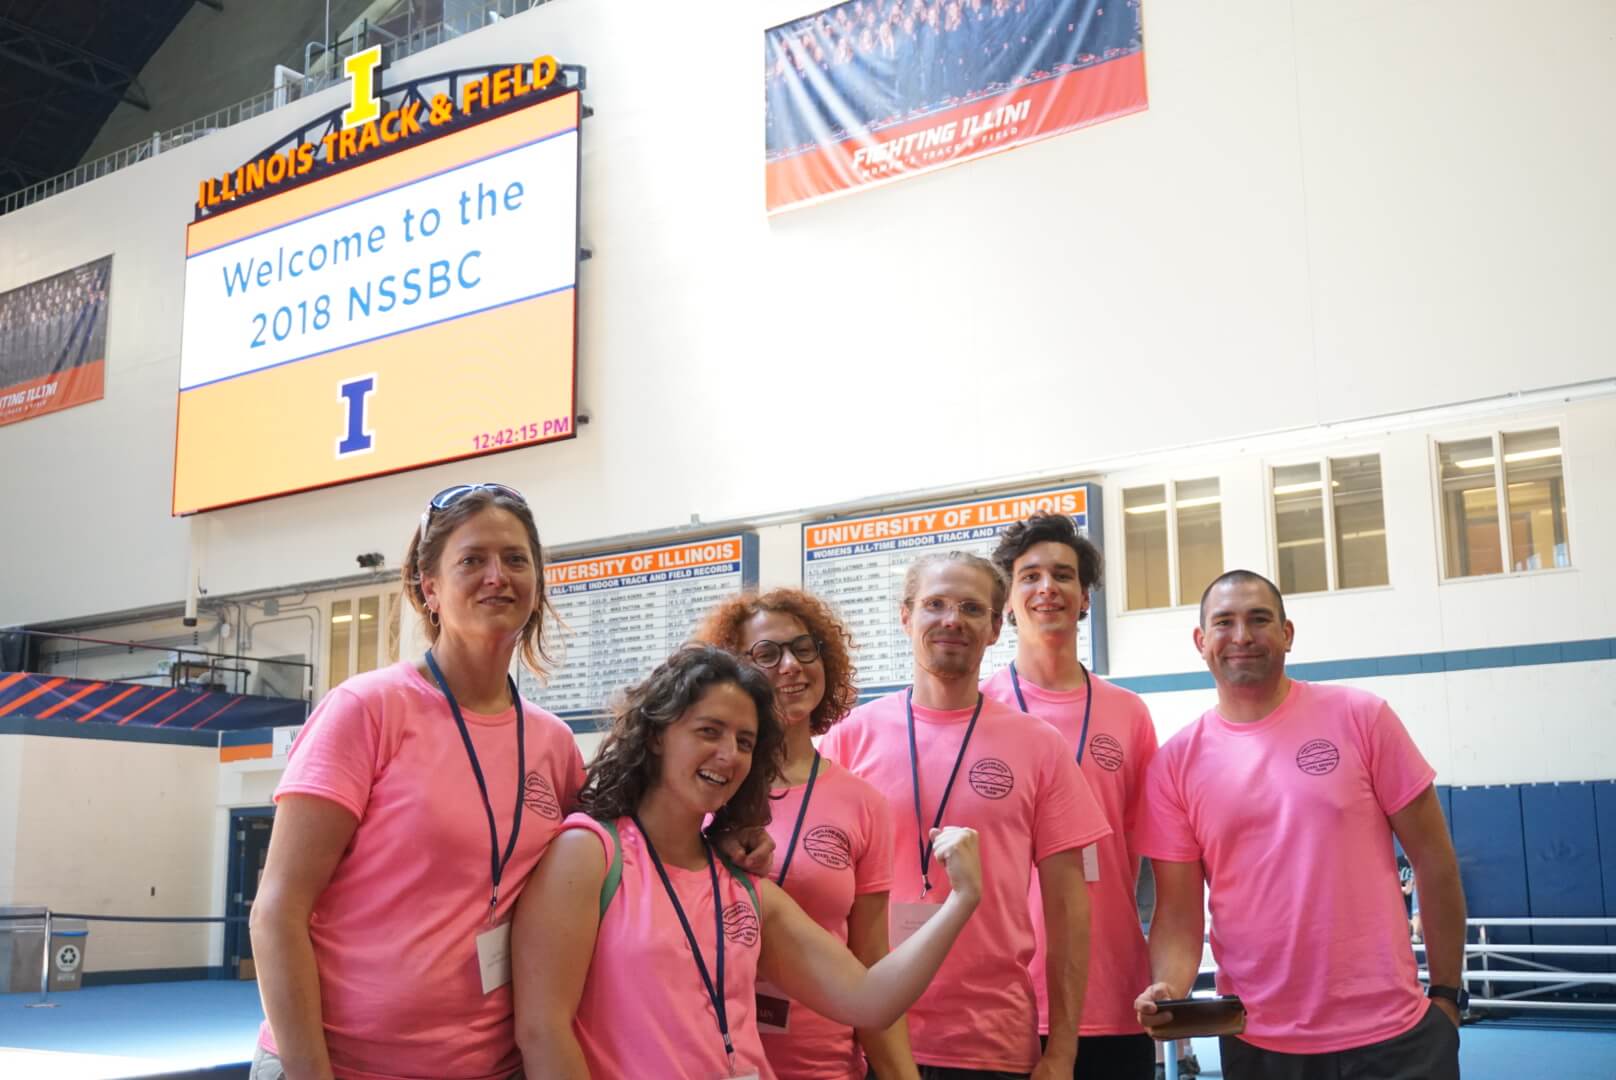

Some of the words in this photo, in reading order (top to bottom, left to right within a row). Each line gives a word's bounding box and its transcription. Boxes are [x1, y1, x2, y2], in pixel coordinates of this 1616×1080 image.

[198, 143, 313, 208] ILLINOIS
[323, 101, 421, 165] TRACK
[429, 93, 453, 127] &
[463, 55, 559, 115] FIELD
[852, 122, 957, 169] FIGHTING
[961, 99, 1032, 137] ILLINI
[222, 225, 386, 298] Welcome
[403, 208, 440, 242] to
[459, 181, 525, 225] the
[249, 294, 331, 348] 2018
[348, 250, 482, 321] NSSBC
[473, 423, 538, 449] 12:42:15
[543, 416, 569, 435] PM
[813, 513, 938, 545] UNIVERSITY
[943, 507, 971, 527] OF
[978, 495, 1076, 523] ILLINOIS
[813, 546, 852, 560] WOMENS
[854, 541, 896, 554] ALL-TIME
[898, 535, 935, 548] INDOOR
[937, 530, 970, 543] TRACK
[972, 528, 993, 539] AND
[544, 559, 626, 583] NIVERSITY
[631, 554, 655, 571] OF
[658, 544, 734, 568] ILLINOIS
[551, 582, 587, 595] ALL-TIME
[589, 578, 619, 590] INDOOR
[621, 575, 648, 586] TRACK
[650, 572, 667, 582] AND
[668, 568, 692, 579] FIELD
[694, 563, 735, 575] RECORDS
